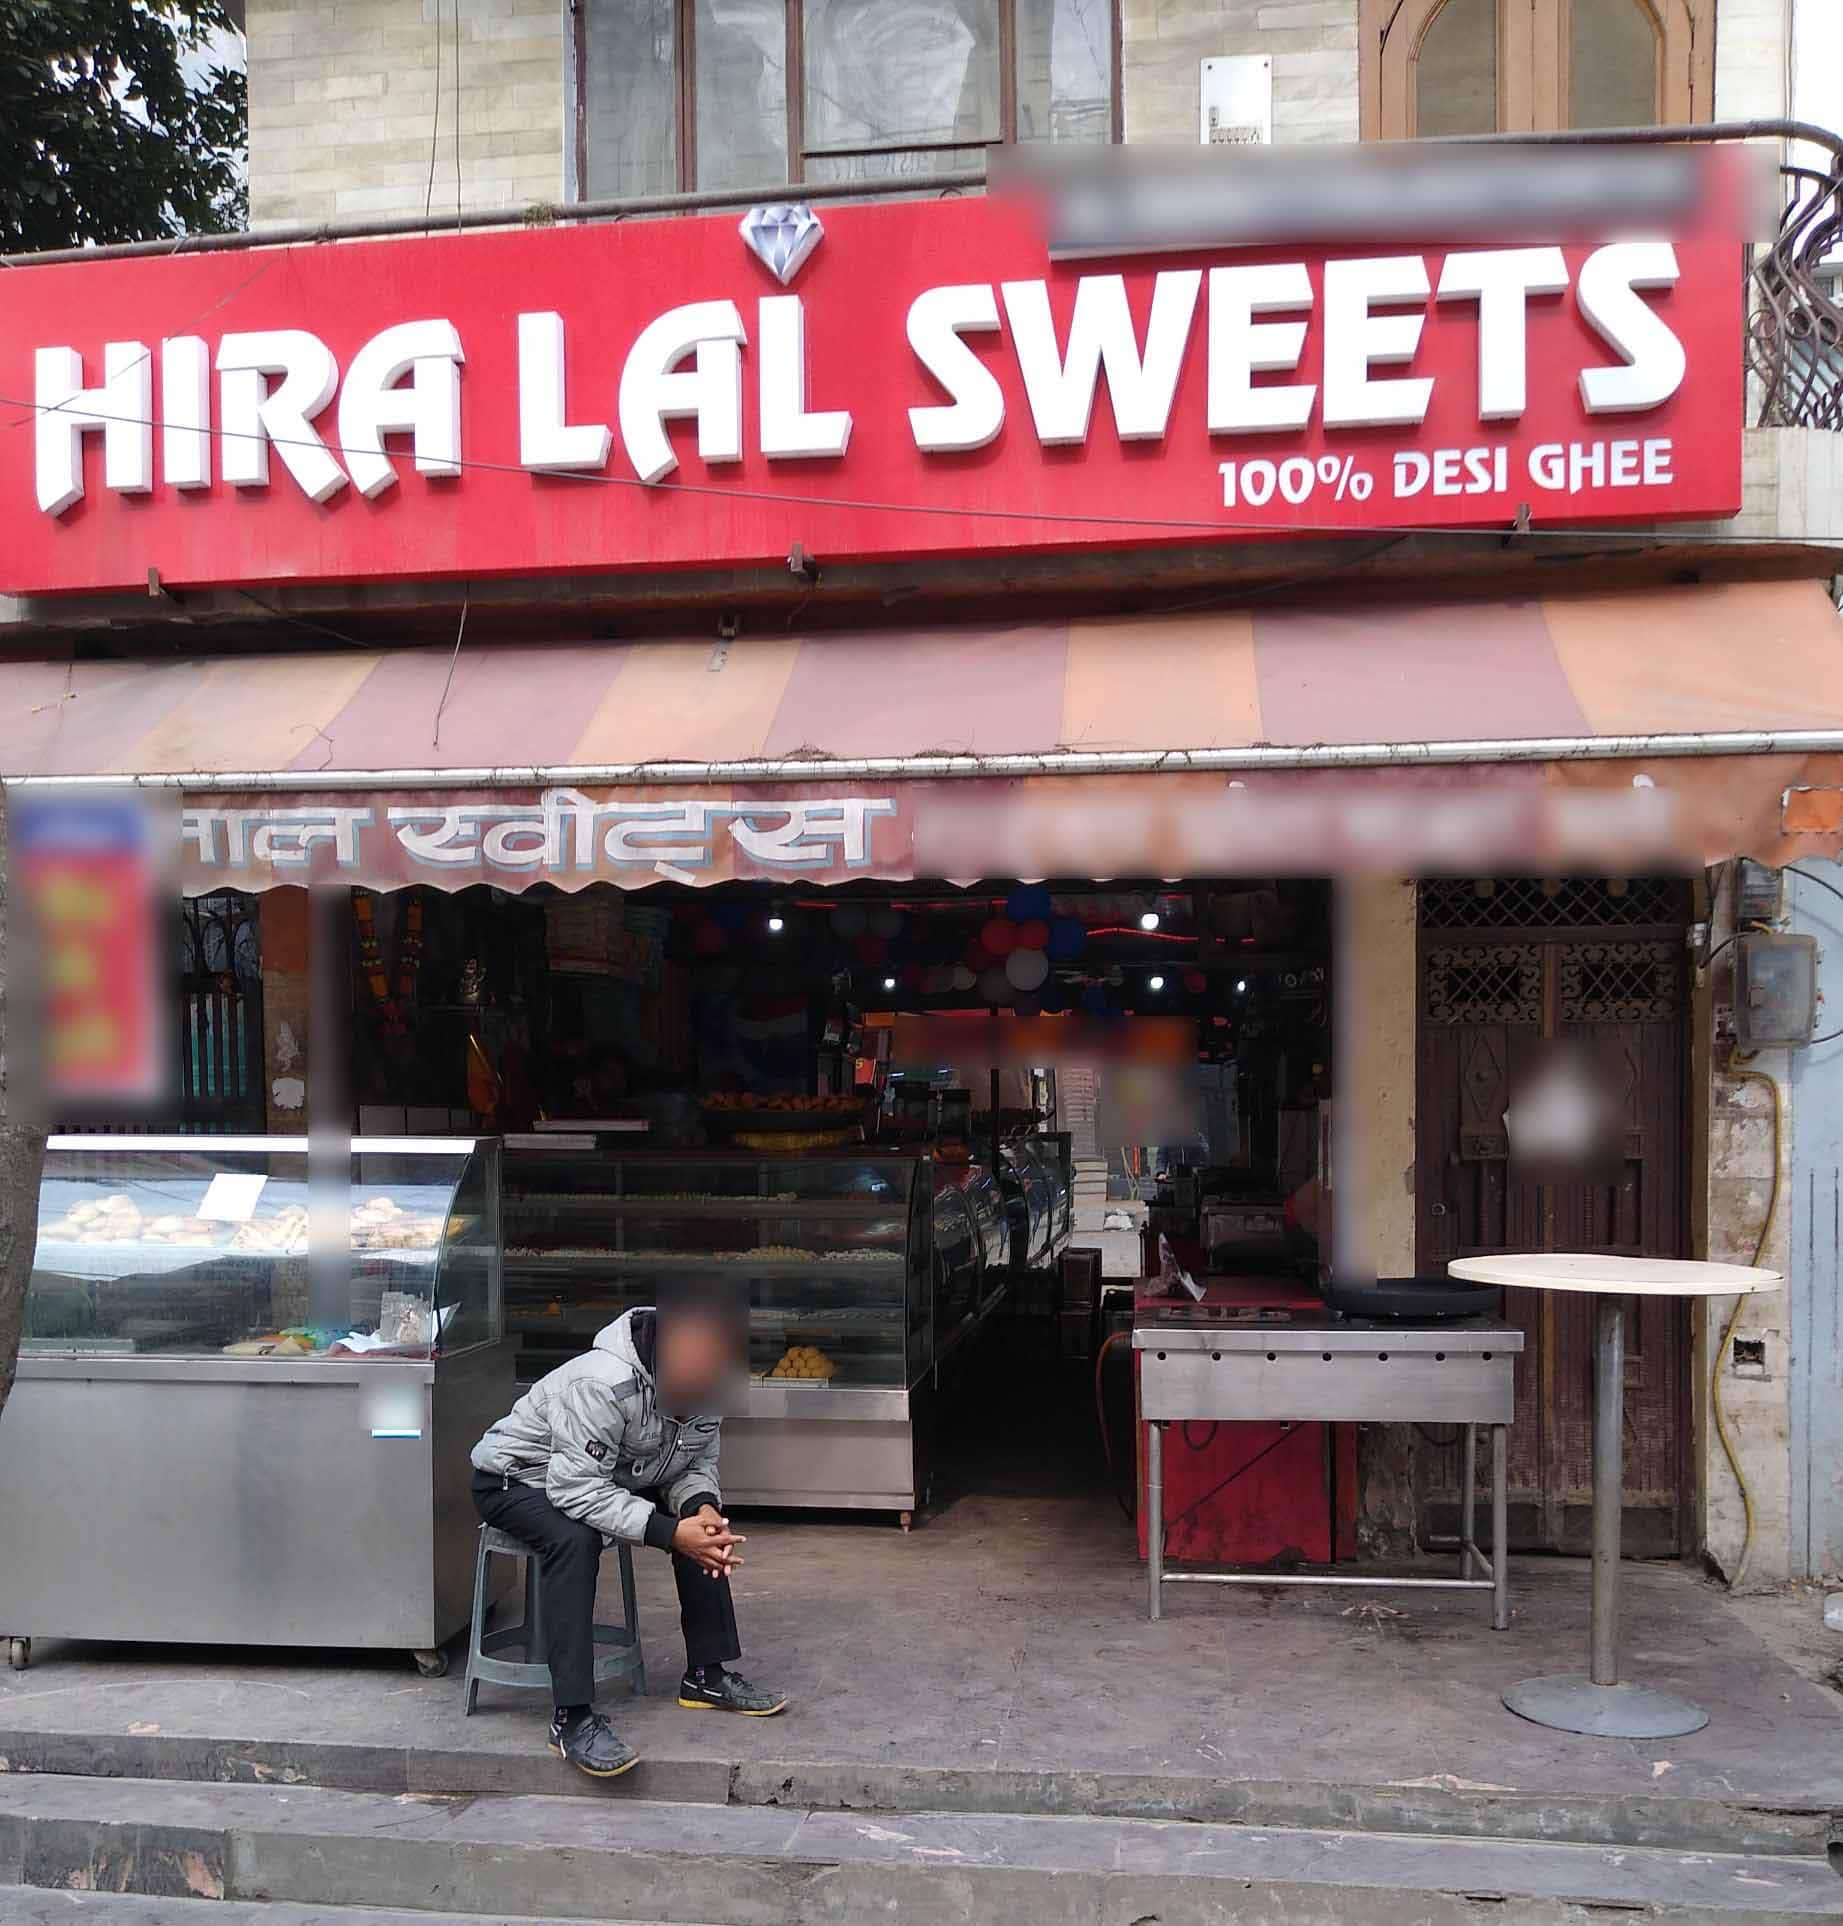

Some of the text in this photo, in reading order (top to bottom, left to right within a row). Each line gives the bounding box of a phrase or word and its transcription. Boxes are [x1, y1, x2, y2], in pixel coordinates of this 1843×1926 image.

[34, 242, 1687, 516] HIRA LAL SWEETS
[1219, 437, 1675, 508] 100% DESI GHEE
